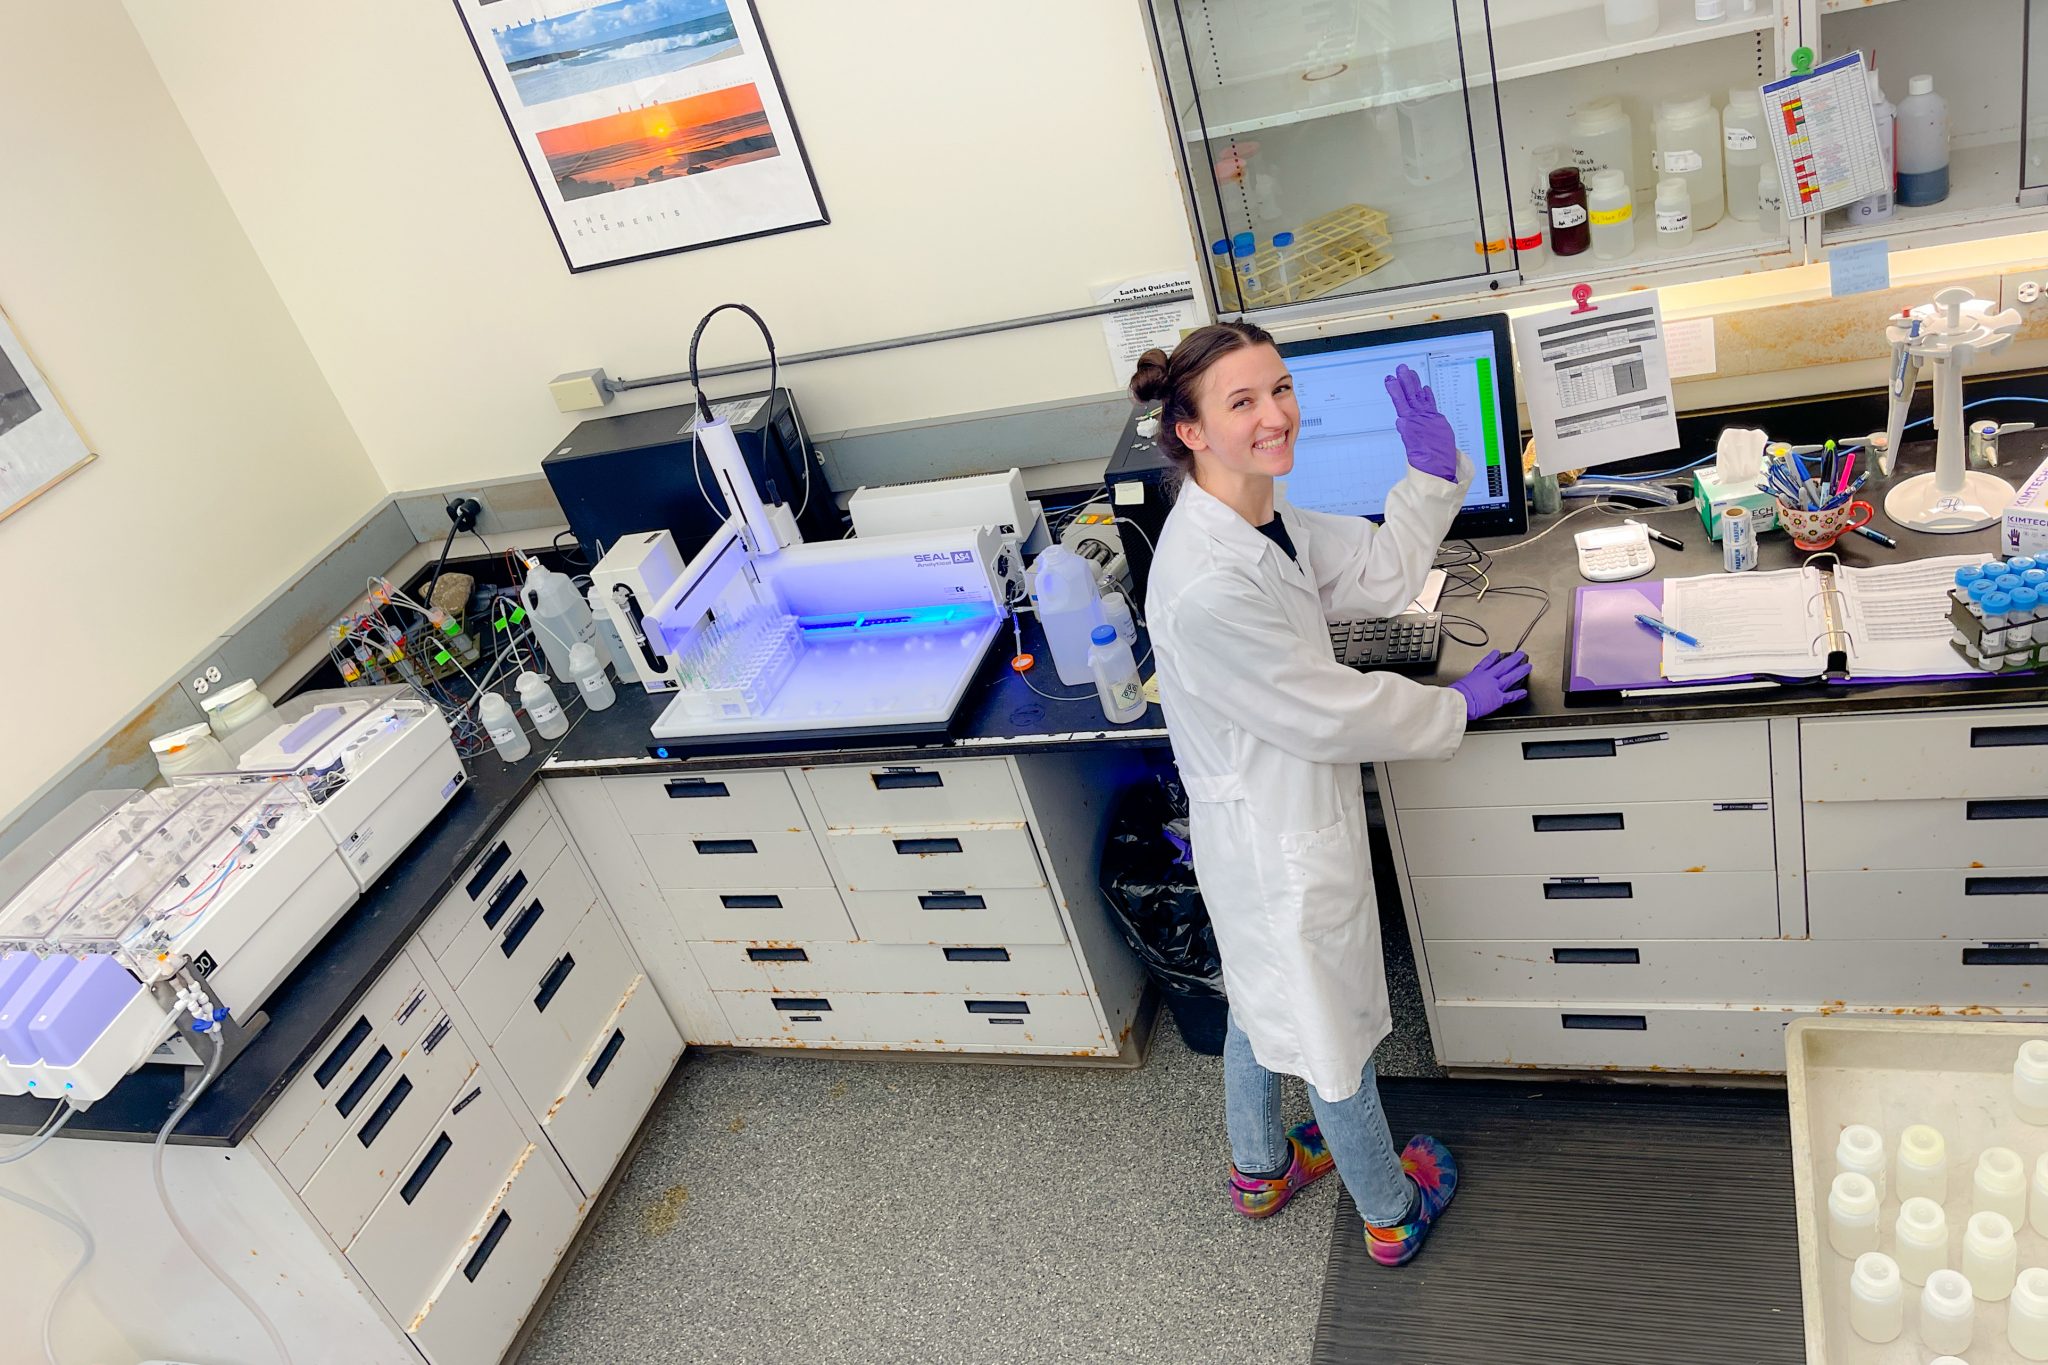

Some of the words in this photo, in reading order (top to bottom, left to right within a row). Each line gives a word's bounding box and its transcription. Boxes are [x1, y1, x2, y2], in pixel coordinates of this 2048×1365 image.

[573, 213, 606, 227] THE
[577, 209, 680, 237] ELEMENTS
[1119, 287, 1147, 296] Lachat
[2007, 515, 2048, 527] KIMTEC
[914, 552, 950, 562] SEAL
